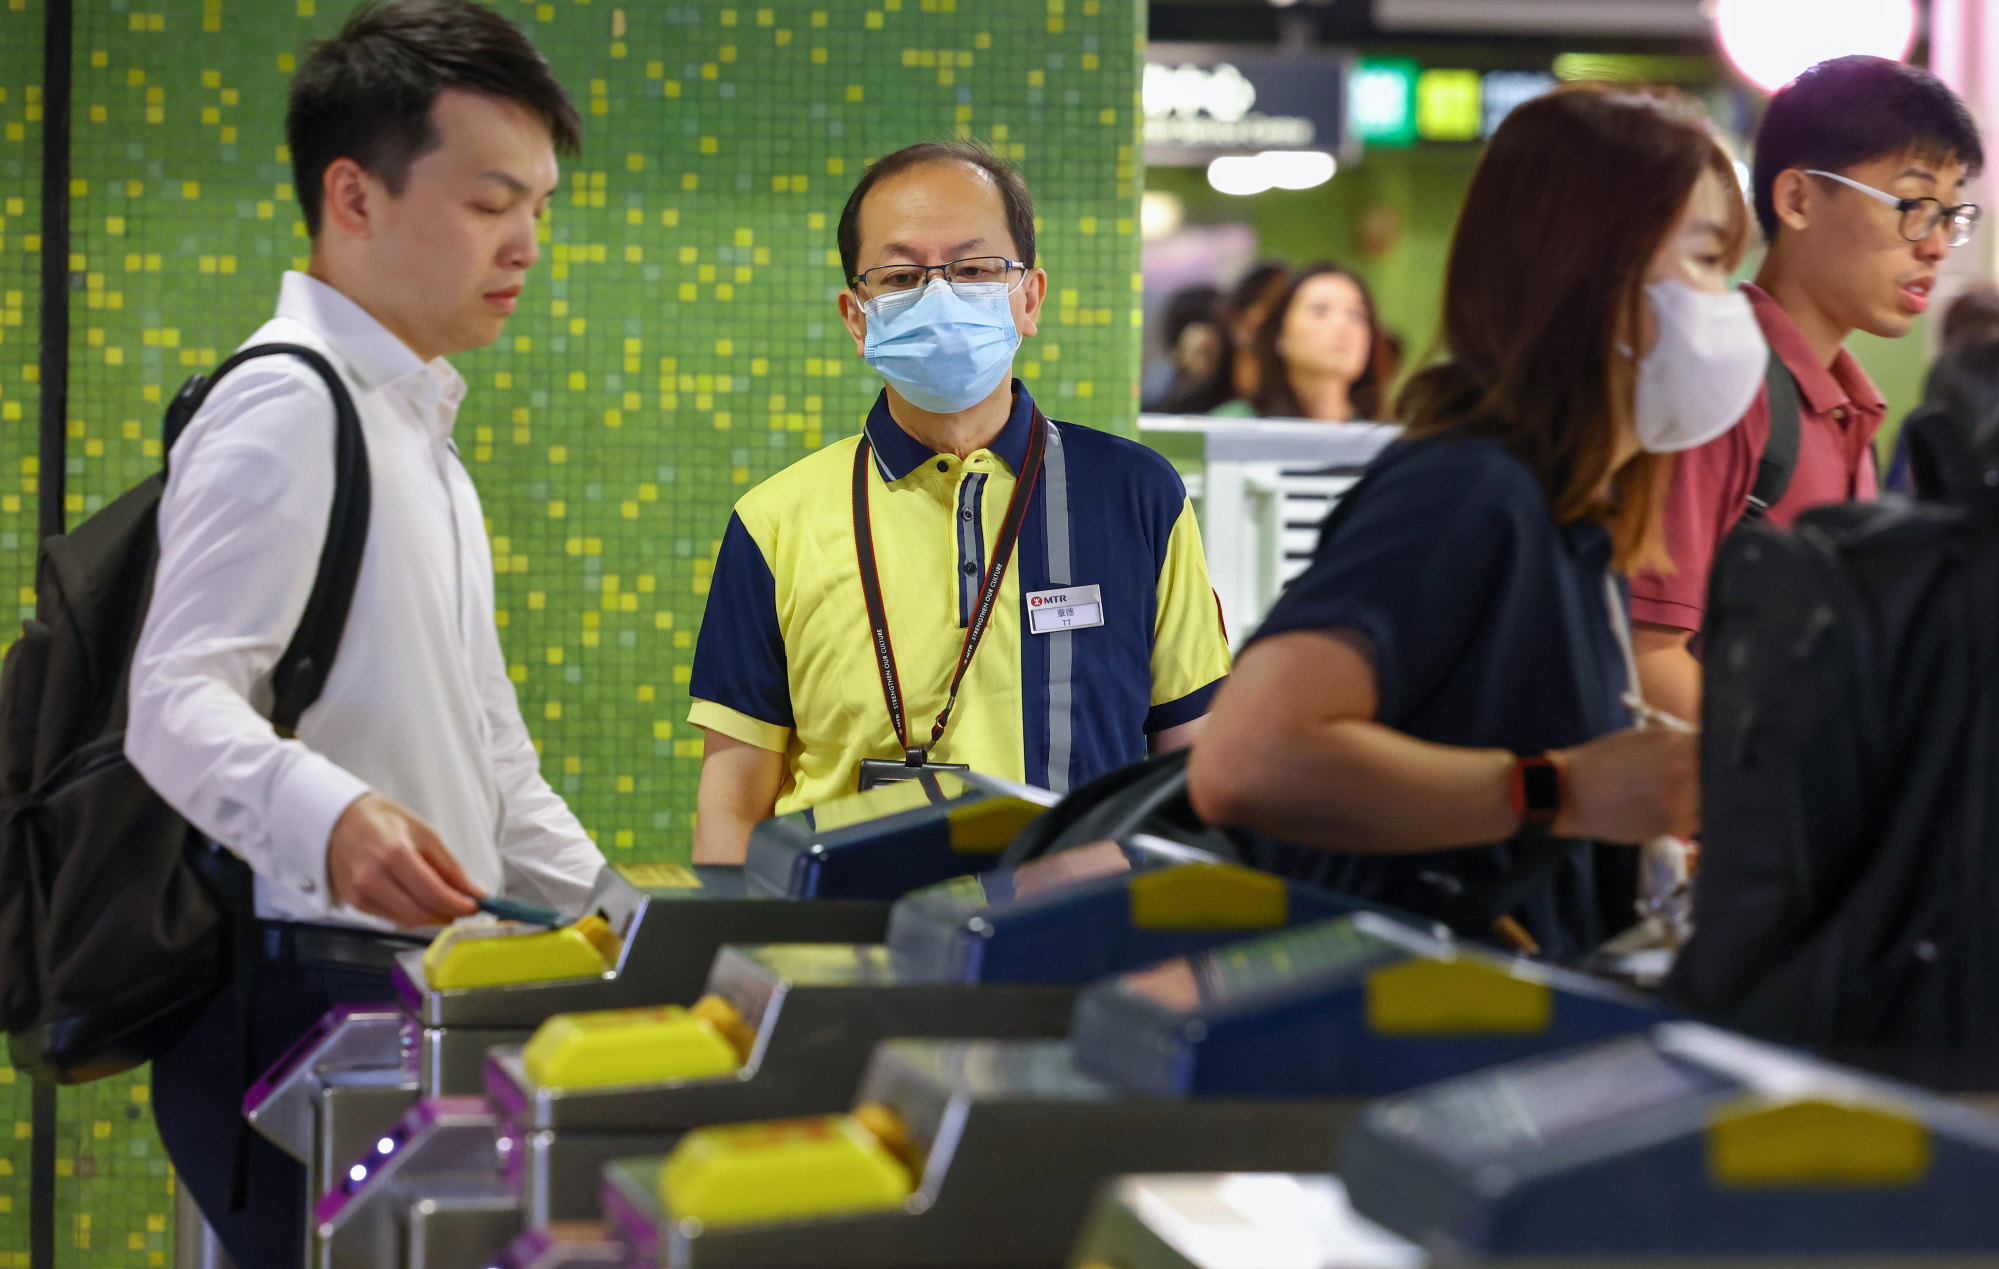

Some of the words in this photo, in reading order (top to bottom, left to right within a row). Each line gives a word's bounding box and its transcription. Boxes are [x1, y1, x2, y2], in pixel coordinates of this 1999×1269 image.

[971, 602, 989, 641] STRENGTHEN
[985, 588, 994, 602] OUR
[990, 562, 1003, 588] CULTURE
[1043, 594, 1067, 605] MTR
[877, 629, 887, 654] CULTURE
[882, 655, 890, 669] OUR
[885, 670, 899, 709] STRENGTHEN
